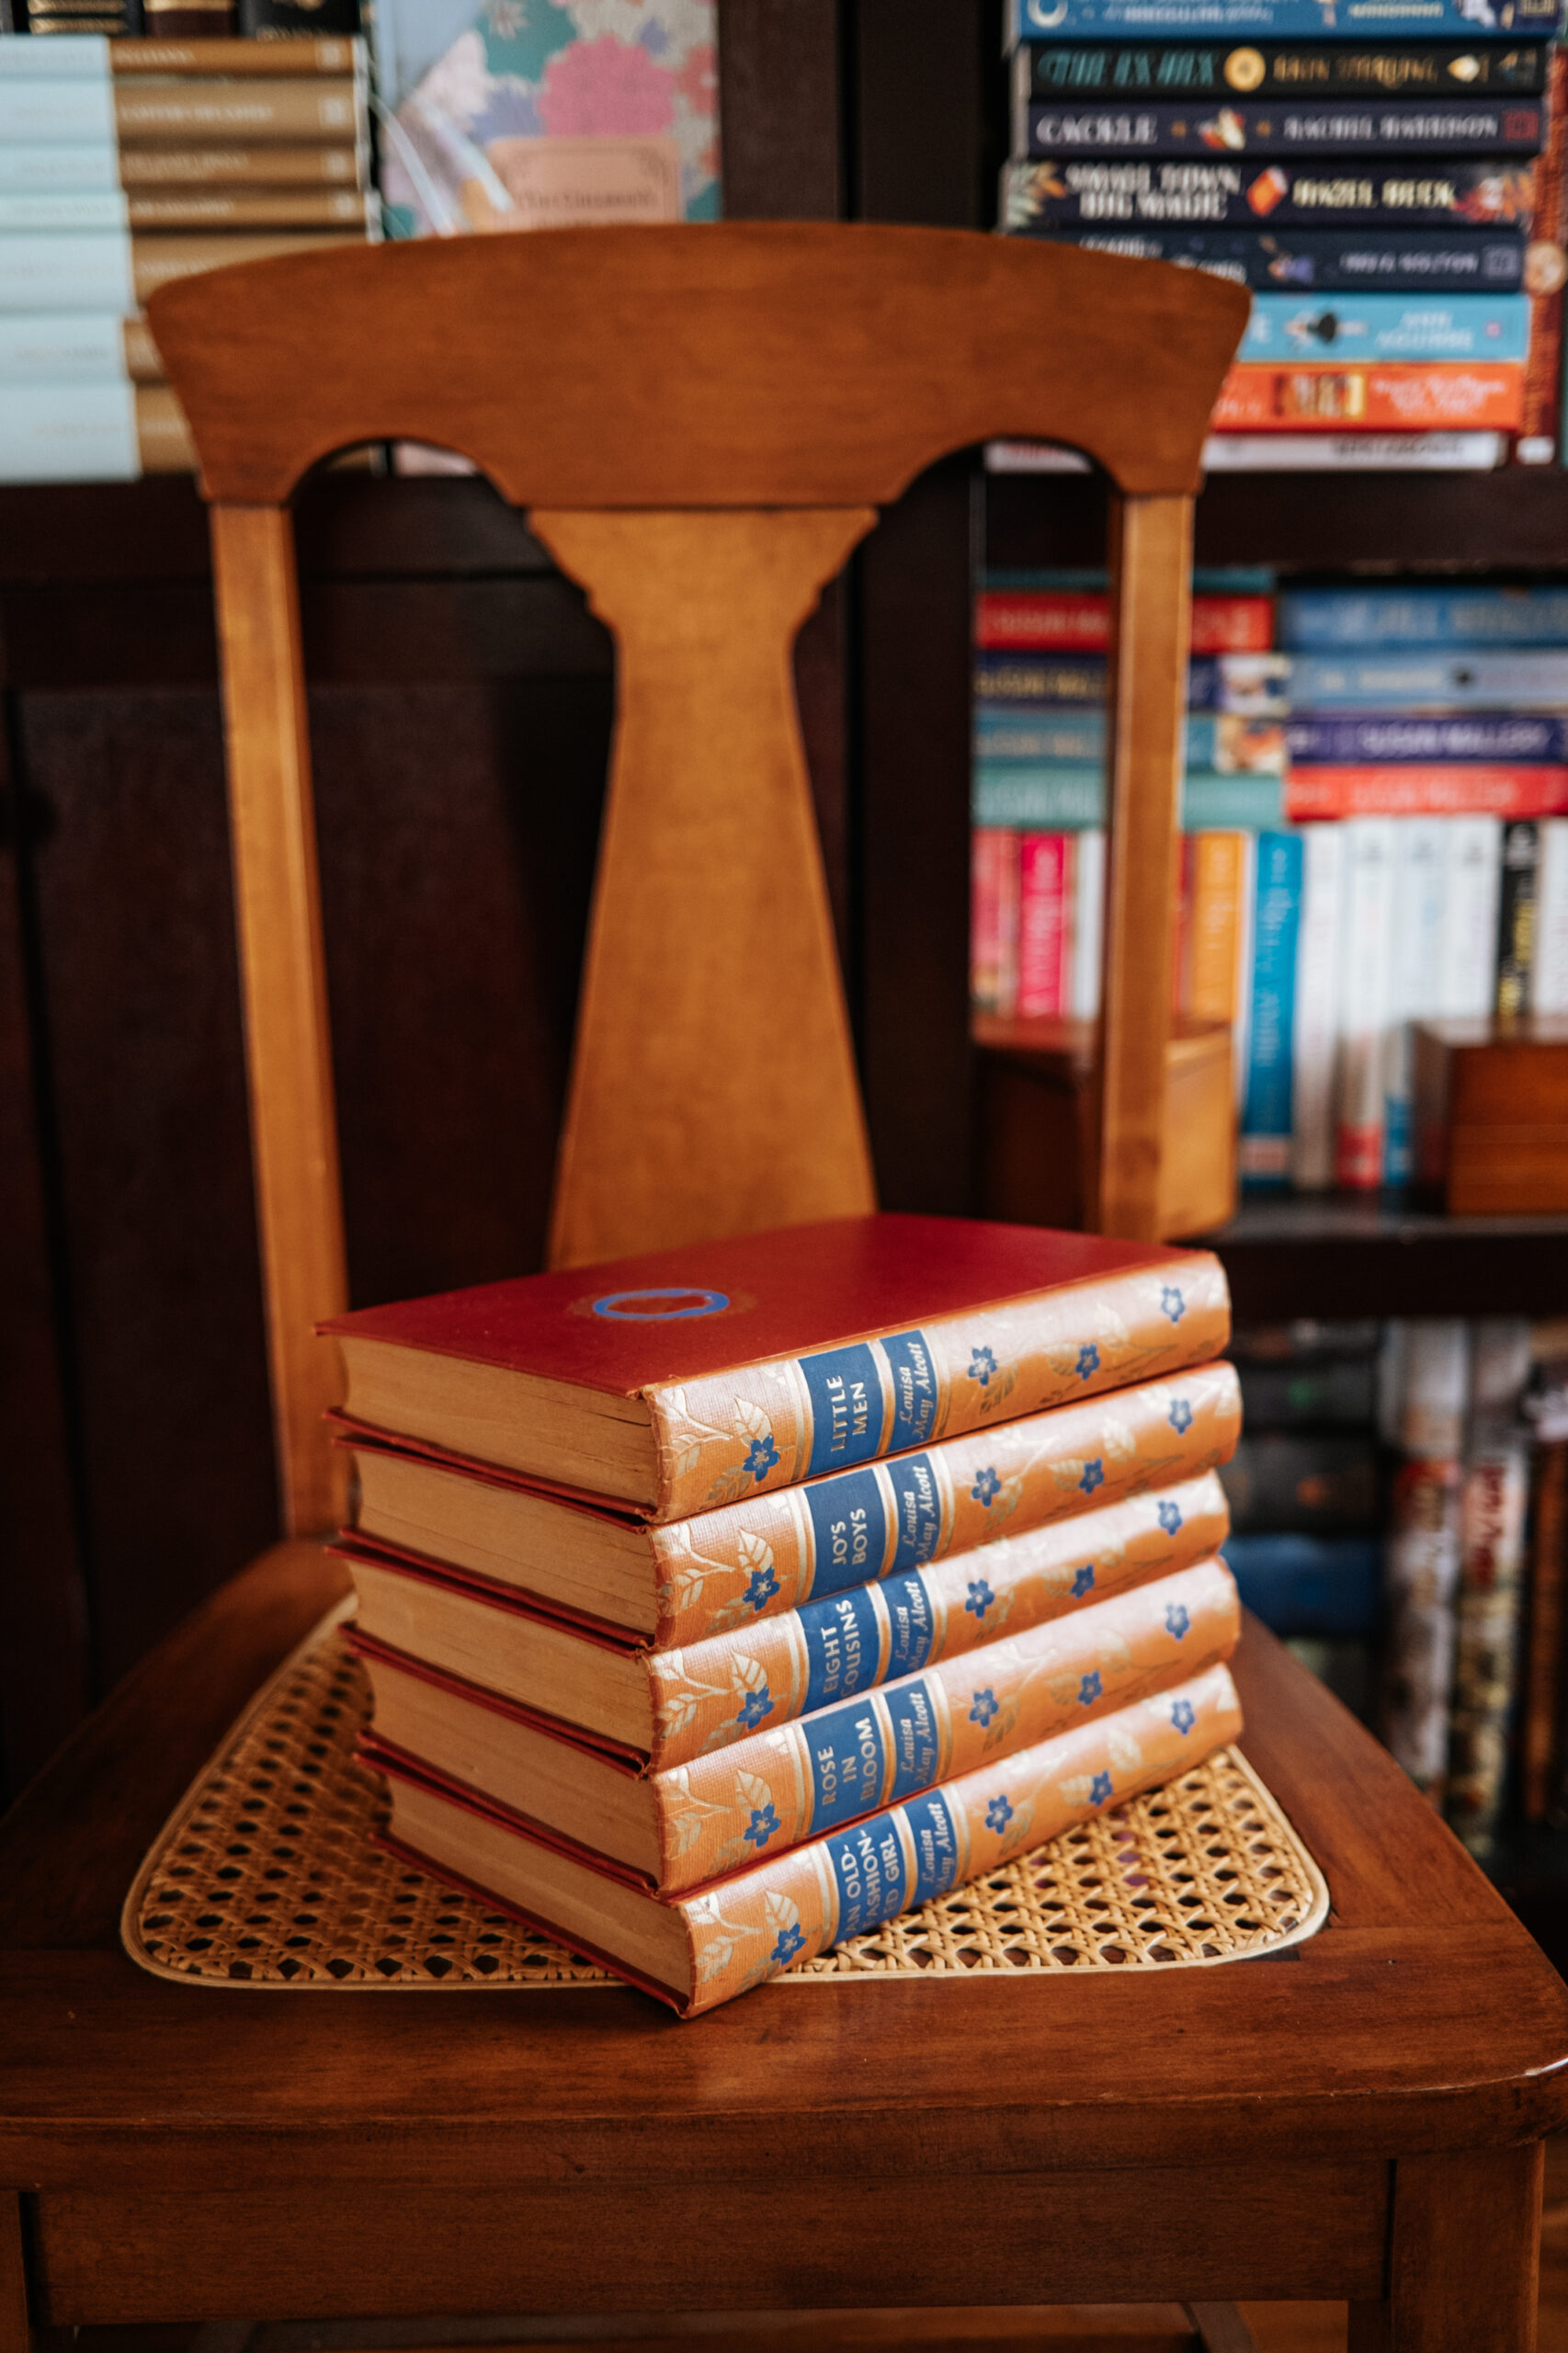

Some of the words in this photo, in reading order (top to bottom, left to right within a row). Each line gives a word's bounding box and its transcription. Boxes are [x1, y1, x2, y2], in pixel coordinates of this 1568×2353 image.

[907, 1342, 933, 1394] Alcott
[826, 1374, 848, 1452] LITTLE
[850, 1381, 869, 1436] MEN
[899, 1366, 915, 1425] Louisa
[912, 1398, 935, 1439] May
[913, 1465, 936, 1518] Alcott
[831, 1521, 848, 1565] JO'S
[850, 1508, 868, 1565] BOYS
[903, 1491, 918, 1548] Louisa
[915, 1518, 938, 1562] May
[904, 1581, 929, 1631] Alcott
[821, 1625, 841, 1694] EIGHT
[836, 1599, 861, 1698] COUSINS
[894, 1606, 911, 1660] Louisa
[907, 1632, 929, 1671] May
[910, 1692, 933, 1742] Alcott
[842, 1756, 858, 1783] IN
[855, 1717, 879, 1802] BLOOM
[900, 1718, 915, 1772] Louisa
[915, 1746, 937, 1784] May
[818, 1745, 837, 1806] ROSE
[927, 1802, 952, 1852] Alcott
[841, 1844, 861, 1899] OLD-
[880, 1833, 901, 1882] GIRL
[920, 1829, 936, 1882] Louisa
[846, 1904, 861, 1931] AN
[883, 1889, 900, 1915] ED
